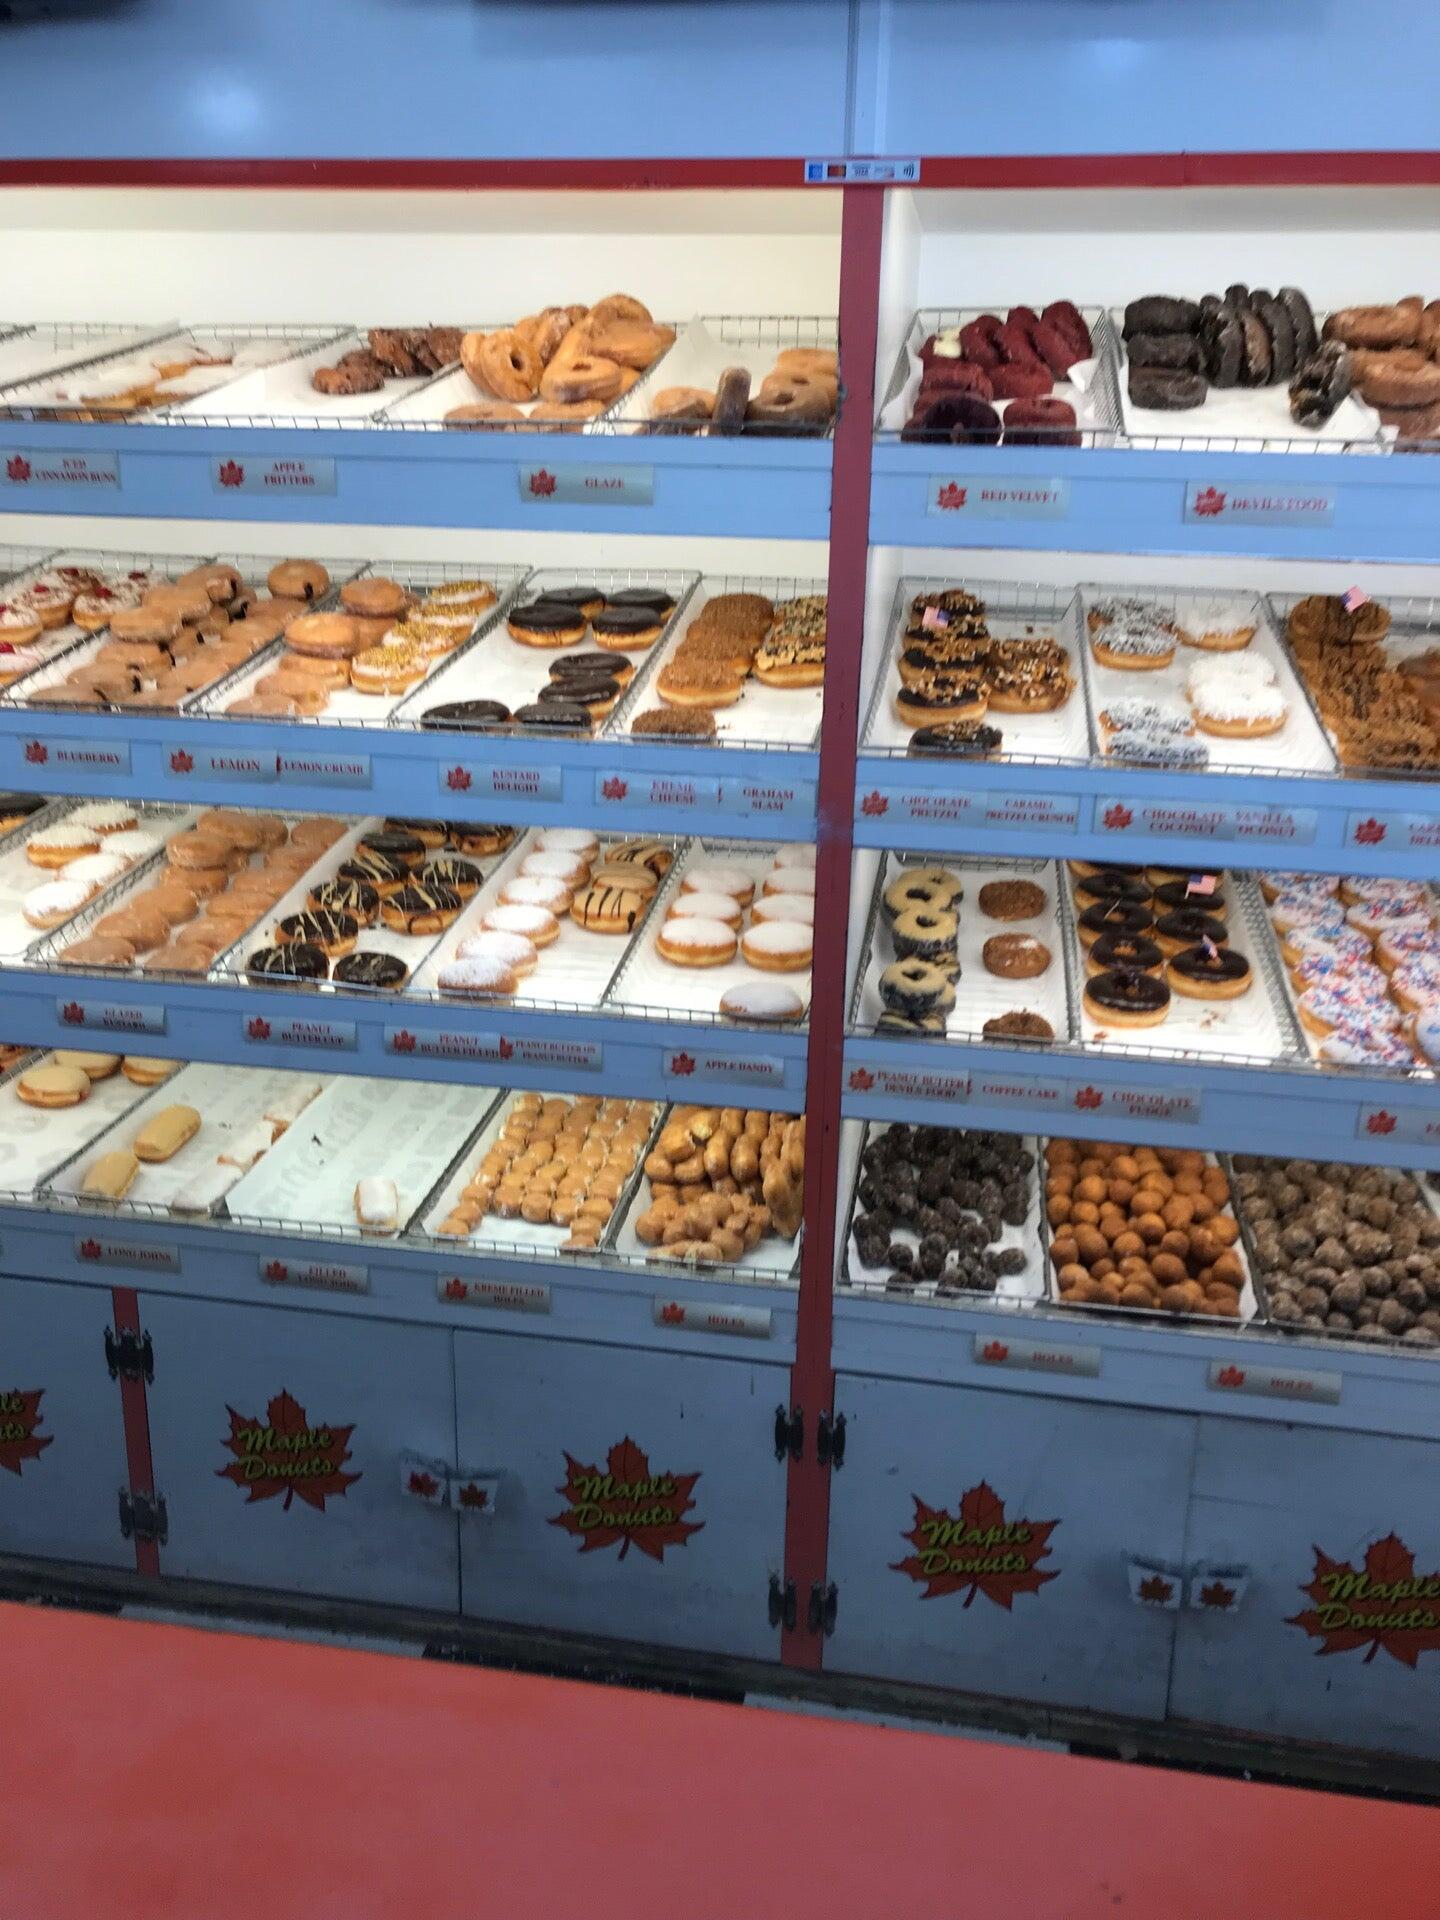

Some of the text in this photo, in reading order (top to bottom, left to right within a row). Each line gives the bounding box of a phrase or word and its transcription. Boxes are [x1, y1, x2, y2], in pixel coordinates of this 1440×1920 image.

[273, 462, 305, 472] APPLE
[264, 475, 316, 486] FRITTERS
[585, 478, 624, 489] GLAZE
[981, 490, 1057, 503] RED VELVET
[1286, 498, 1328, 511] FOOD
[57, 750, 120, 764] BLUEBERRY
[211, 757, 261, 771] LEMON
[284, 761, 364, 776] LEMON CRUMB
[493, 782, 538, 793] DELIGHT
[743, 787, 794, 800] GRAHAM
[752, 801, 784, 811] SLAM
[901, 795, 971, 808] CHOCOLATE
[1005, 799, 1054, 810] CARAMEL
[911, 808, 960, 819] PRETZEL
[1030, 813, 1075, 824] CRUNCH
[1142, 808, 1226, 823] CHOCOLATE
[1150, 821, 1217, 835] COCONUT
[1238, 825, 1297, 837] OCONUT
[292, 1021, 330, 1034] PEANUT
[281, 1032, 344, 1046] BUTTER CUP
[439, 1034, 479, 1046] PEANUT
[421, 1043, 461, 1056] BUTTER
[515, 1040, 547, 1050] PEANUT
[550, 1042, 581, 1053] BUTTER
[522, 1051, 589, 1064] PEANUT BUTTER
[704, 1059, 774, 1074] APPLE DANDY
[877, 1070, 964, 1089] PEANUT BUTTER
[925, 1087, 957, 1098] FOOD
[982, 1085, 1058, 1099] COFFEE CAKE
[1112, 1090, 1191, 1108] CHOCOLATE
[1128, 1104, 1170, 1116] FUDGE
[708, 1314, 745, 1327] HOLES
[237, 1427, 333, 1454] Maple
[239, 1454, 333, 1480] Donuts
[572, 1472, 676, 1503] Maple
[572, 1501, 675, 1529] Donuts
[920, 1518, 1032, 1550] Maple
[917, 1548, 1030, 1576] Donuts
[1320, 1572, 1440, 1603] Maple
[1316, 1602, 1440, 1630] Donuts
